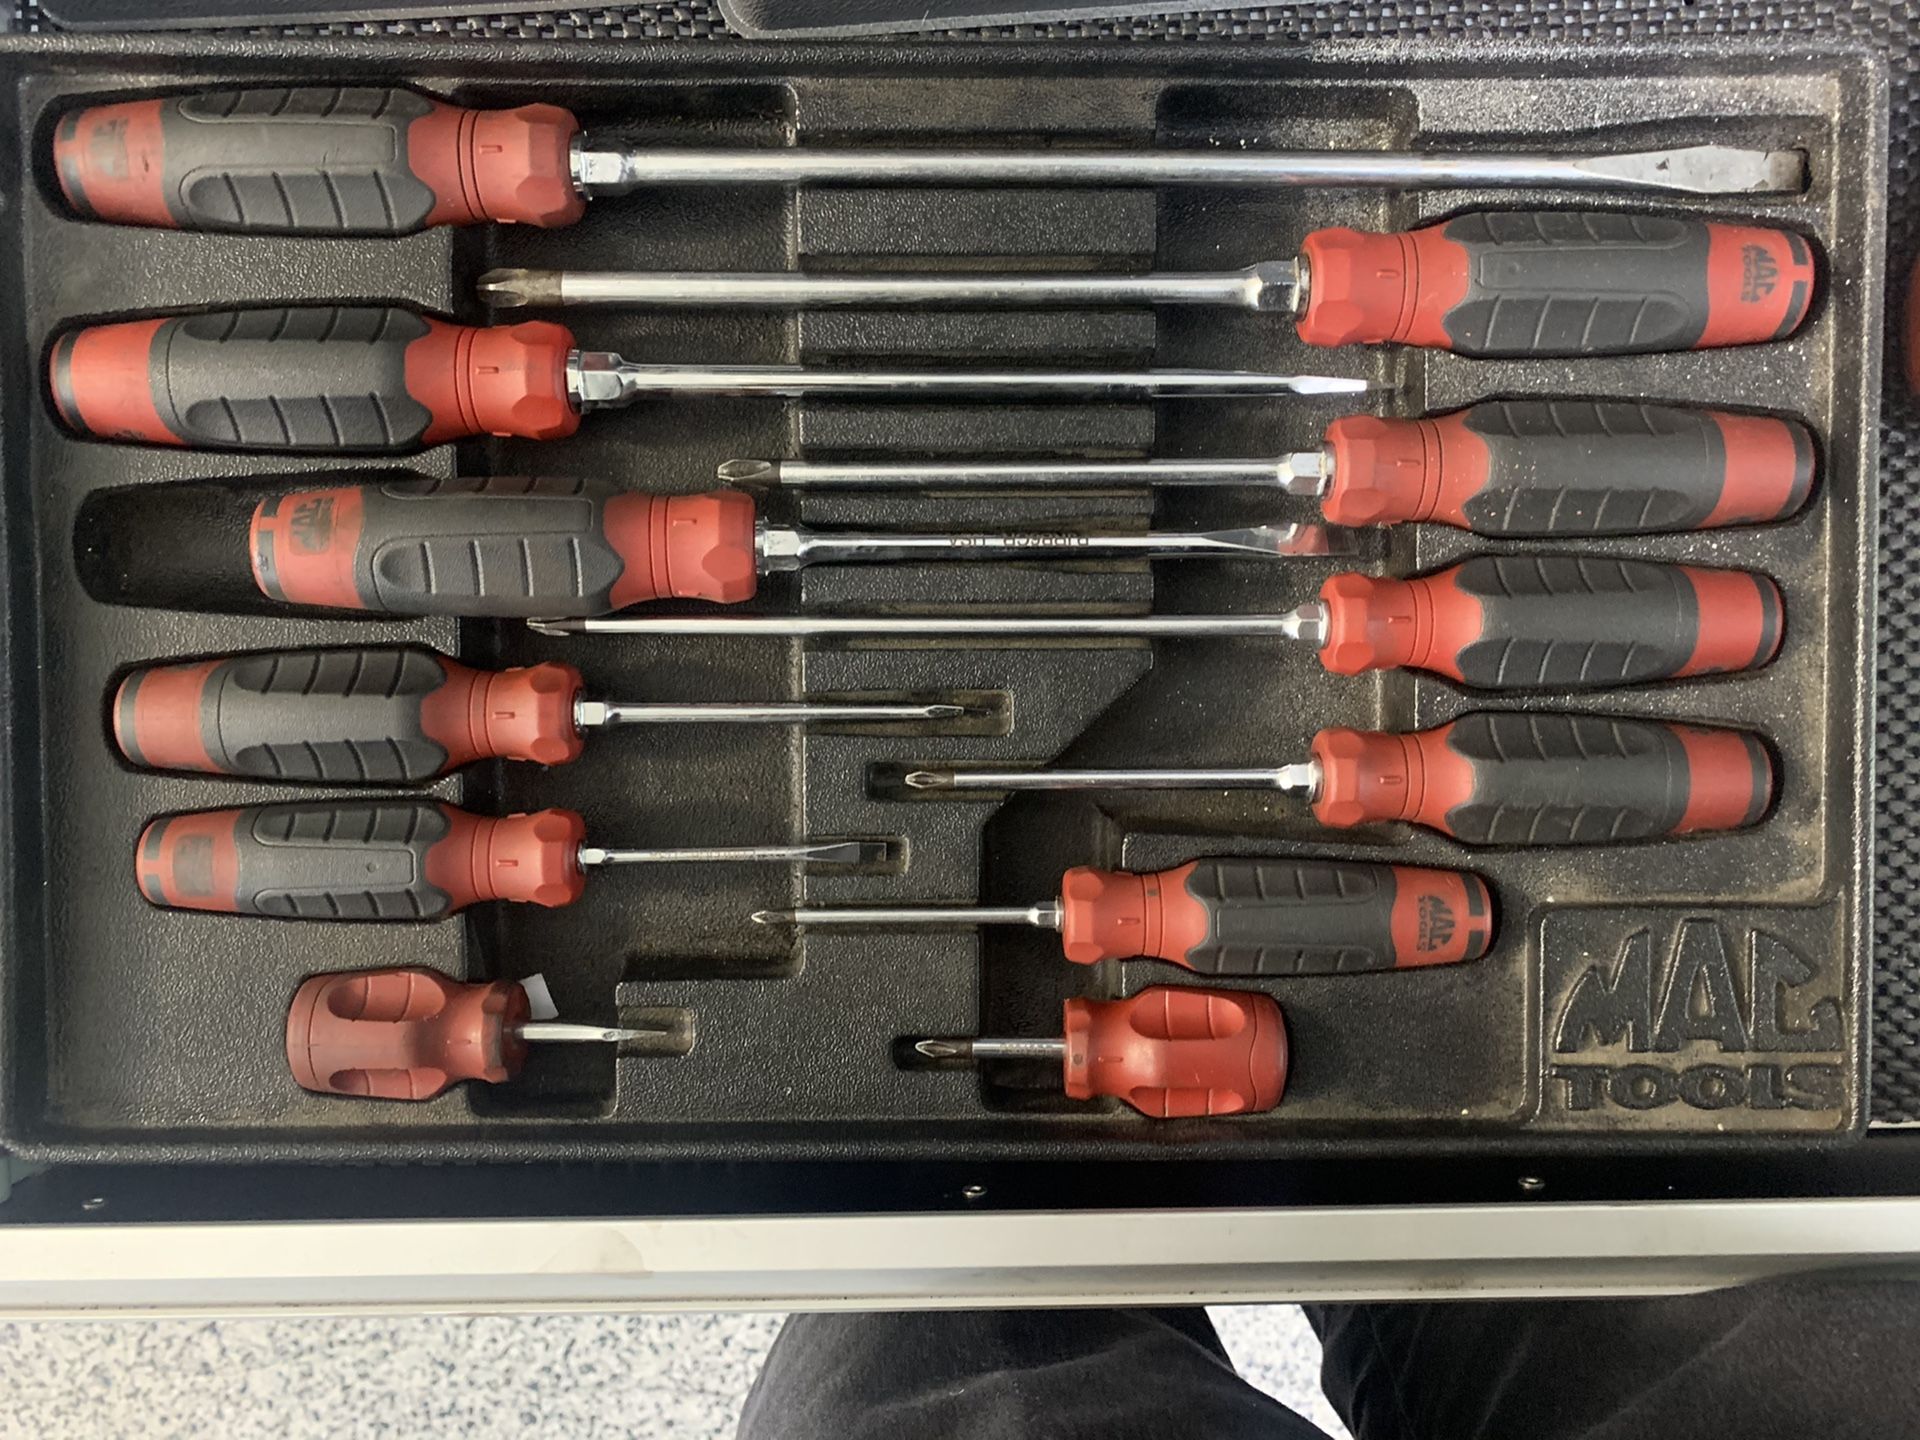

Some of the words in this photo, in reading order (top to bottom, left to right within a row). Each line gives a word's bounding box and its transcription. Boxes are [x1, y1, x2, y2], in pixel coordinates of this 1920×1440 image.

[1750, 245, 1779, 303] MAC
[1428, 895, 1456, 952] MAC
[1554, 917, 1846, 1053] MAC
[1547, 1063, 1846, 1110] TOOLS
